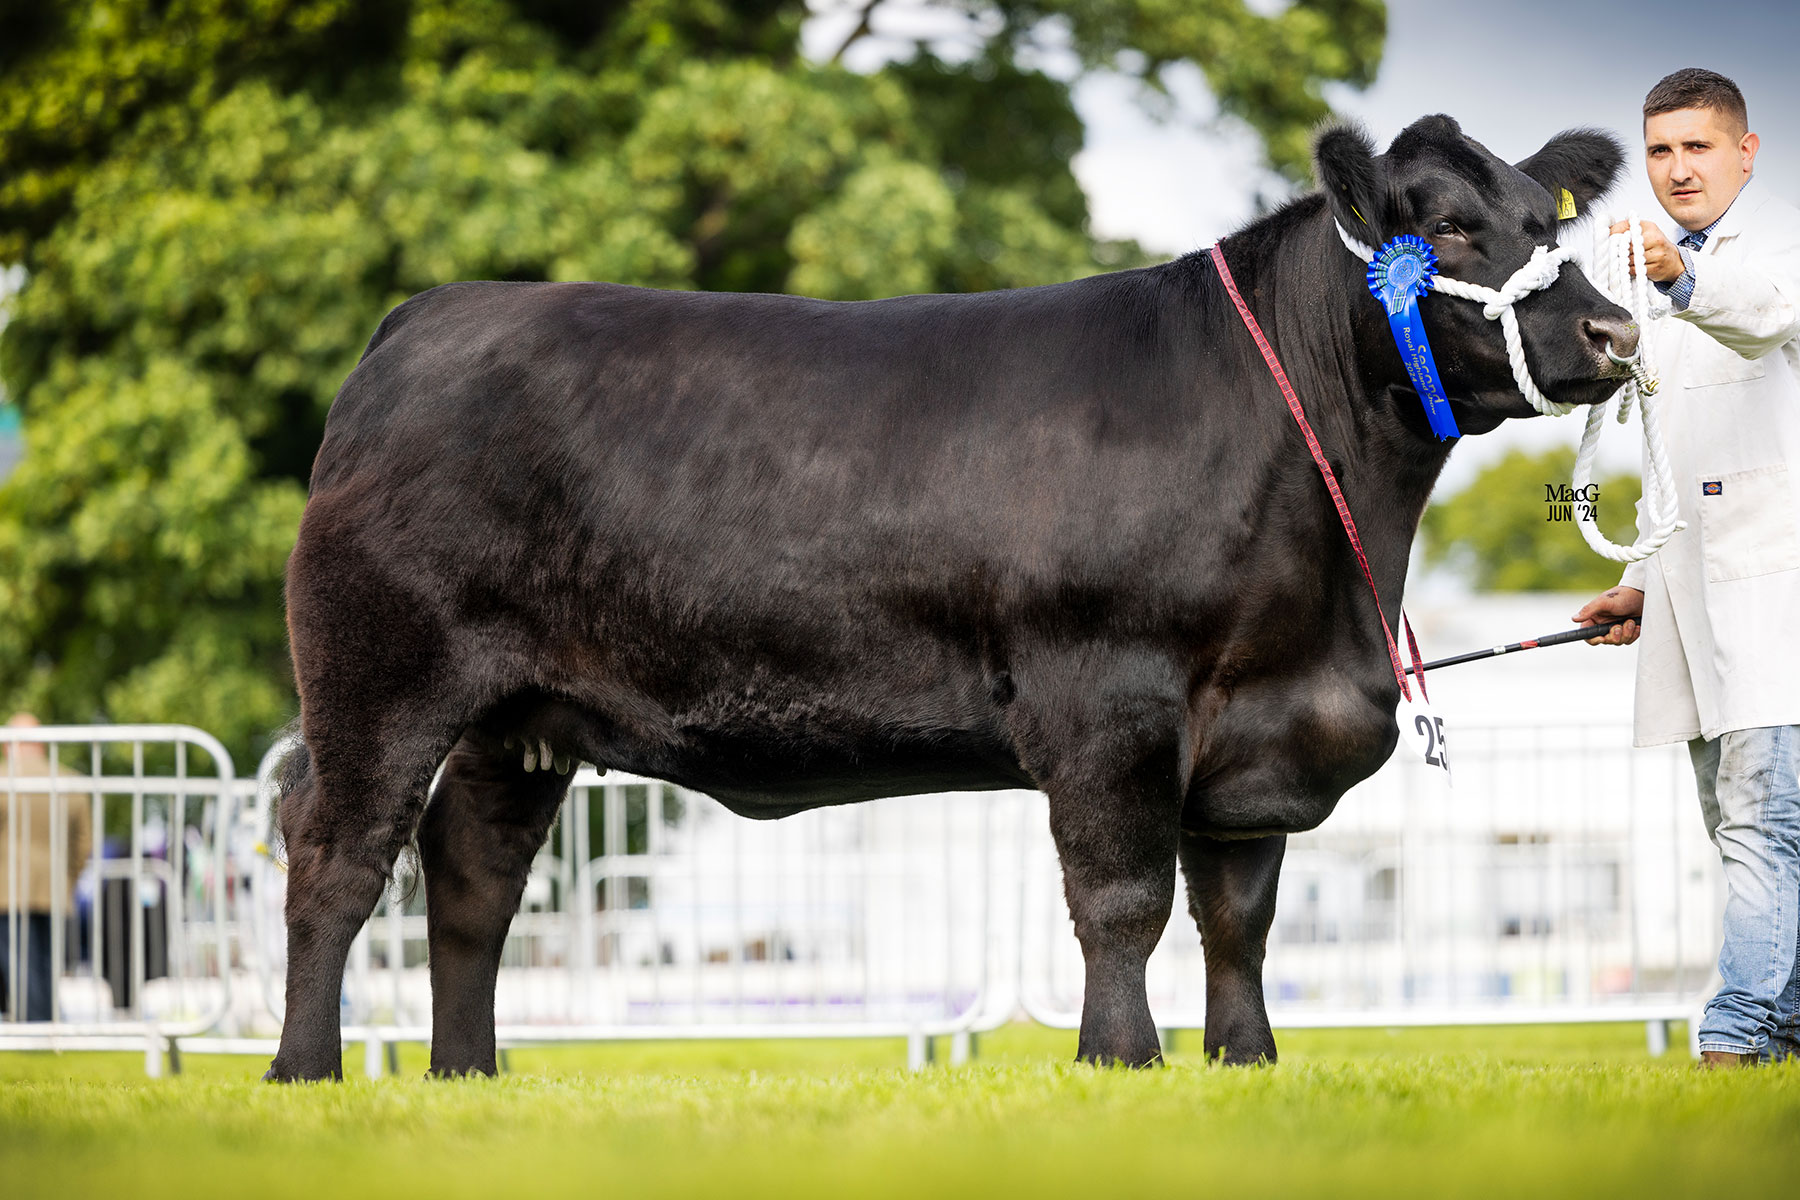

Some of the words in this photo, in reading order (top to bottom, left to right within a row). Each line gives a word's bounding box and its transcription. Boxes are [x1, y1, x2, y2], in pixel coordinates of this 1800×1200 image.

[1403, 326, 1415, 351] Royal
[1411, 353, 1428, 391] Highland
[1405, 361, 1417, 382] 2024
